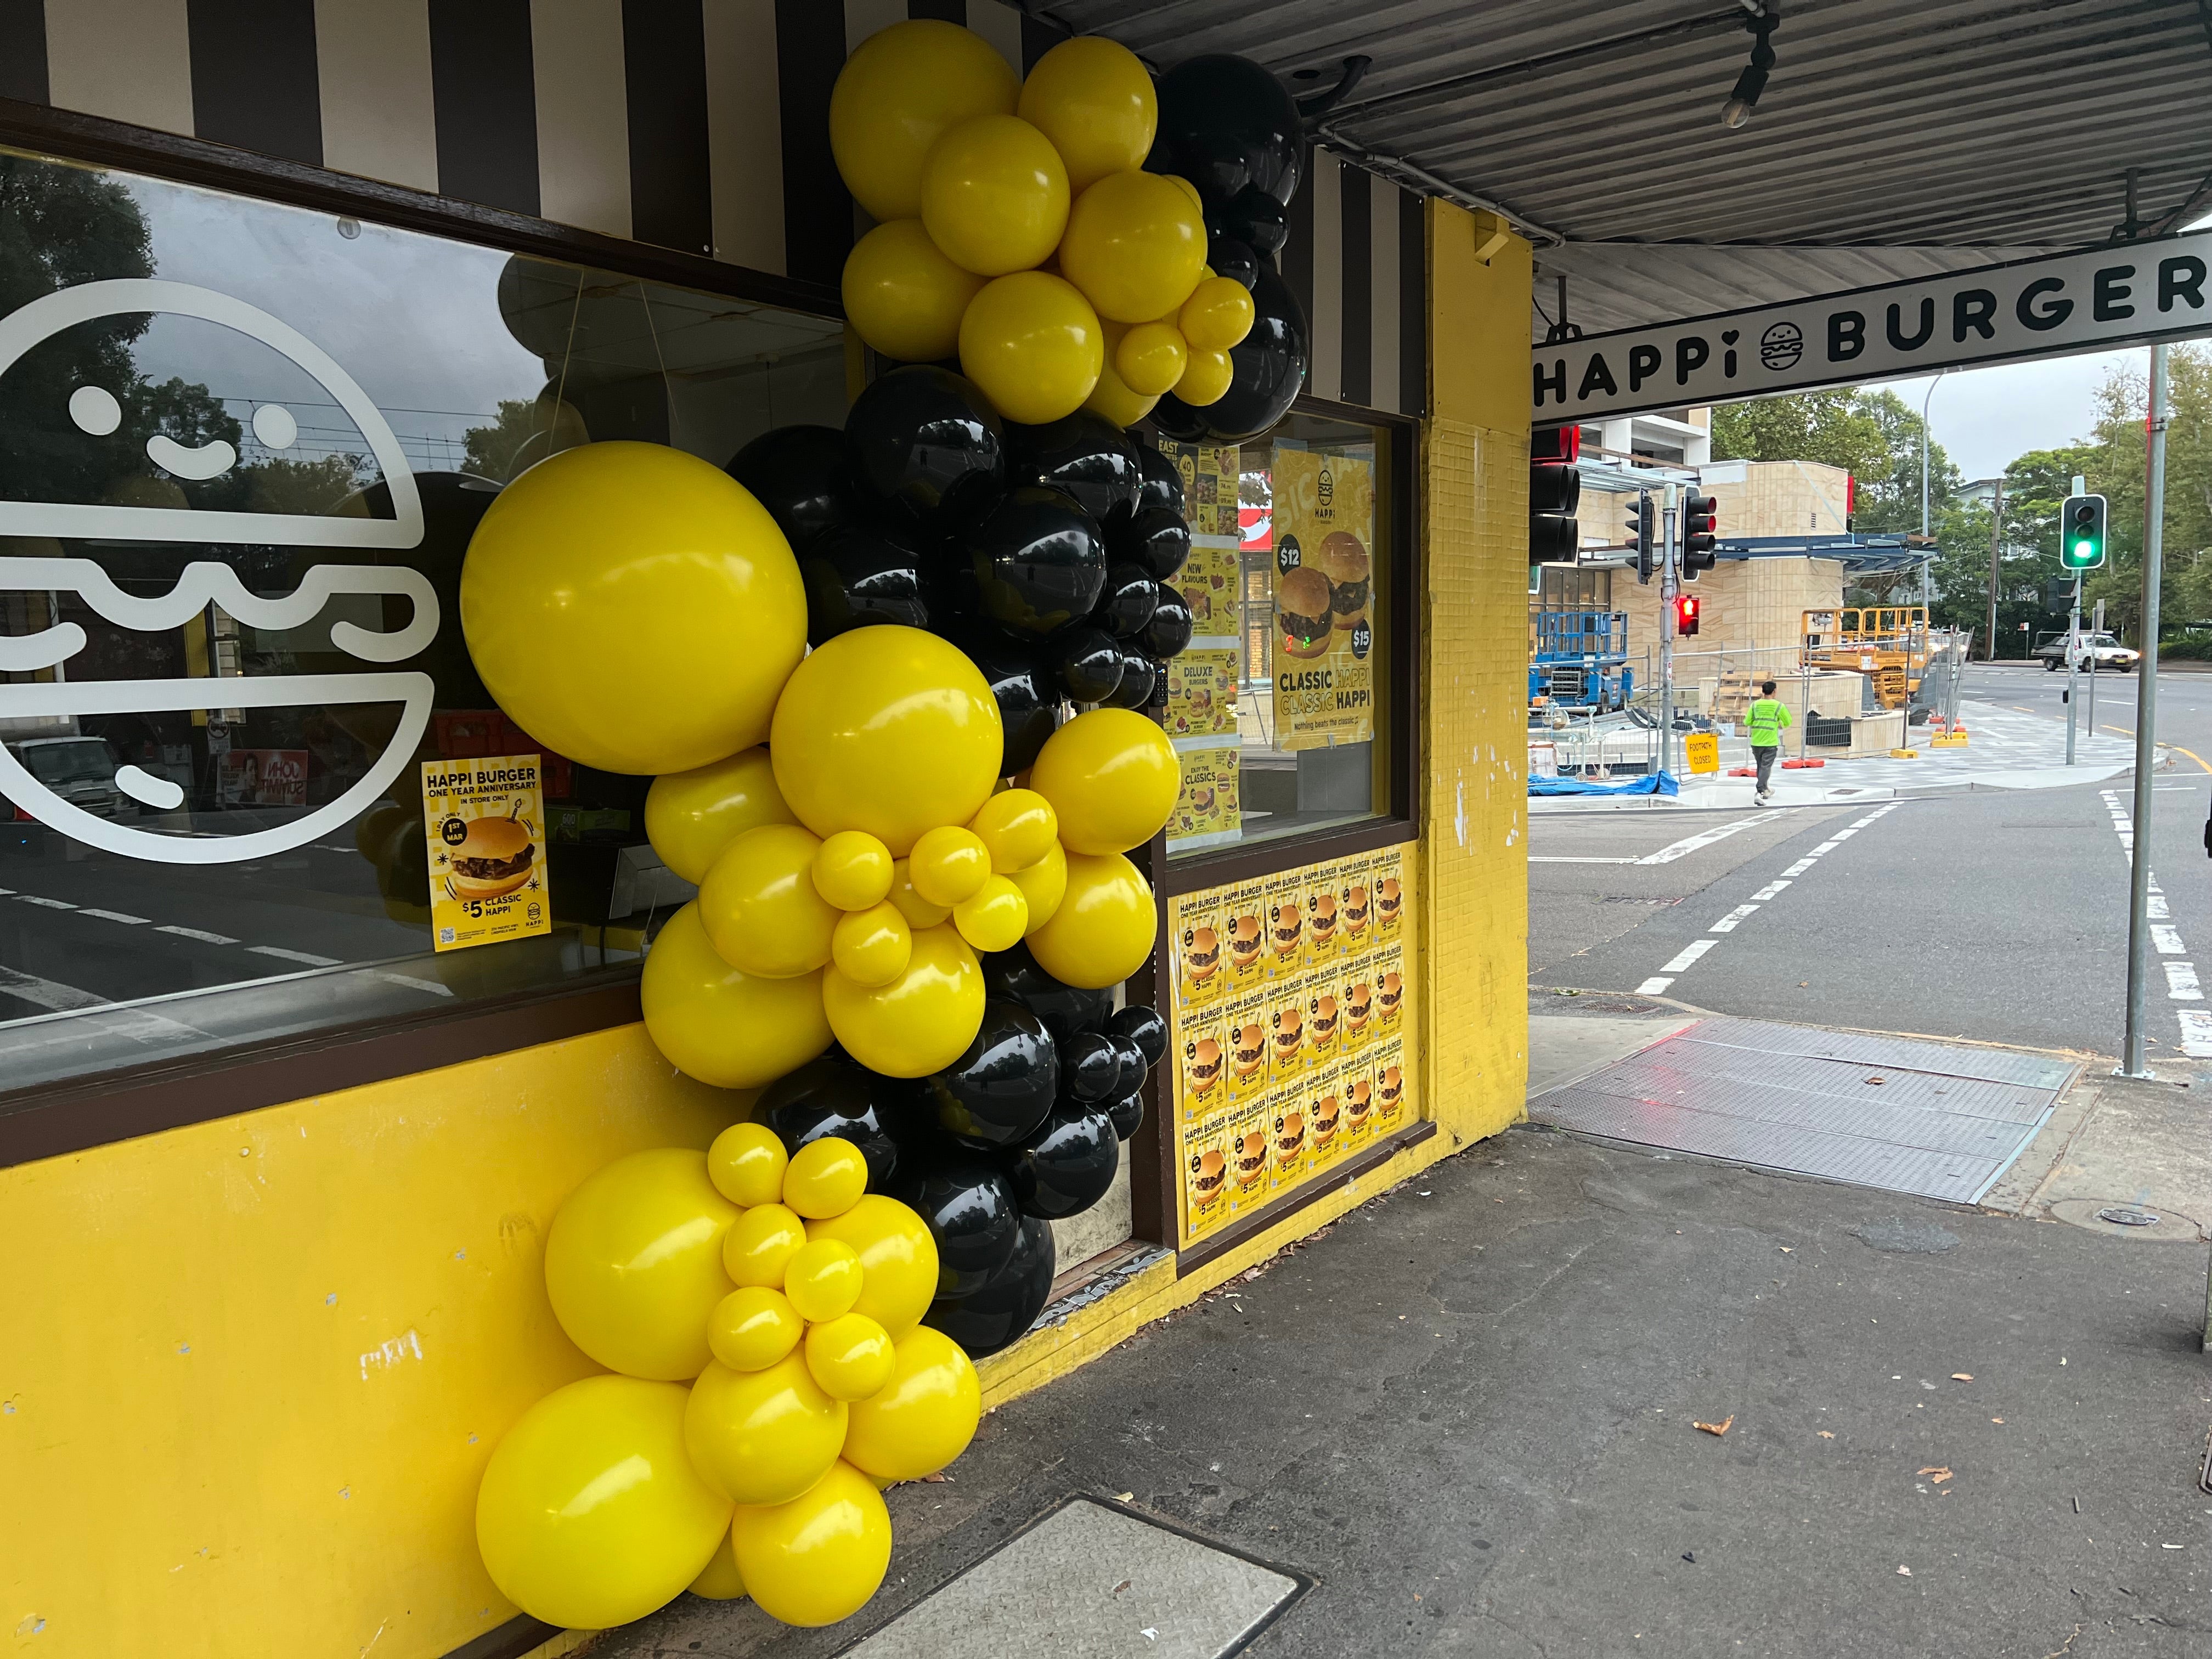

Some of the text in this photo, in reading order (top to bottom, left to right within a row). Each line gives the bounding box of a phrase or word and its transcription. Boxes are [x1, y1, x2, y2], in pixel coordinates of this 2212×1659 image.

[1827, 256, 2207, 362] BURGER
[1281, 548, 1299, 566] $12
[1188, 563, 1201, 574] NEW
[1182, 575, 1207, 584] FLAVOURS
[1353, 630, 1369, 647] $15
[1184, 667, 1213, 678] DELUXE
[1280, 668, 1370, 692] CLASSIC HAPPI
[1280, 690, 1370, 715] CLASSIC HAPPI
[1295, 721, 1313, 730] Nothing
[1338, 717, 1354, 725] classic
[1690, 742, 1712, 752] FOOTPATH
[1694, 755, 1711, 764] CLOSED
[427, 768, 535, 788] HAPPI BURGER
[1185, 772, 1216, 785] CLASSICS
[429, 781, 536, 798] ONE YEAR ANNIVERSARY
[437, 816, 445, 828] DAY
[448, 823, 460, 833] 1ST
[1372, 851, 1401, 865] HAPPI BURGER
[1339, 859, 1370, 873] HAPPI BURGER
[1304, 866, 1337, 881] HAPPI BURGER
[1265, 875, 1301, 890] HAPPI BURGER
[486, 894, 522, 906] CLASSIC
[1223, 885, 1262, 901] HAPPI BURGER
[1241, 893, 1262, 903] ANNIVERSARY
[462, 900, 482, 918] $5
[1180, 895, 1220, 912] HAPPI BURGER
[1198, 904, 1220, 914] ANNIVERSARY
[486, 906, 511, 916] HAPPI
[1373, 945, 1401, 961] HAPPI BURGER
[1340, 955, 1371, 972] HAPPI BURGER
[1236, 965, 1243, 977] $5
[1305, 966, 1338, 984] HAPPI BURGER
[1193, 979, 1200, 992] $5
[1201, 974, 1215, 983] CLASSIC
[1267, 979, 1302, 997] HAPPI BURGER
[1225, 992, 1263, 1012] HAPPI BURGER
[1243, 1000, 1265, 1012] ANNIVERSARY
[1181, 1006, 1222, 1026] HAPPI BURGER
[1200, 1014, 1223, 1026] ANNIVERSARY
[1374, 1038, 1402, 1056] HAPPI BURGER
[1341, 1052, 1372, 1070] HAPPI BURGER
[1239, 1075, 1246, 1087] $5
[1306, 1065, 1339, 1087] HAPPI BURGER
[1204, 1085, 1217, 1094] CLASSIC
[1269, 1081, 1304, 1103] HAPPI BURGER
[1195, 1091, 1203, 1104] $5
[1228, 1098, 1266, 1122] HAPPI BURGER
[1246, 1107, 1266, 1120] ANNIVERSARY
[1184, 1116, 1226, 1141] HAPPI BURGER
[1204, 1124, 1226, 1138] ANNIVERSARY
[1241, 1183, 1248, 1195] $5
[1206, 1195, 1220, 1207] CLASSIC
[1198, 1203, 1205, 1217] $5
